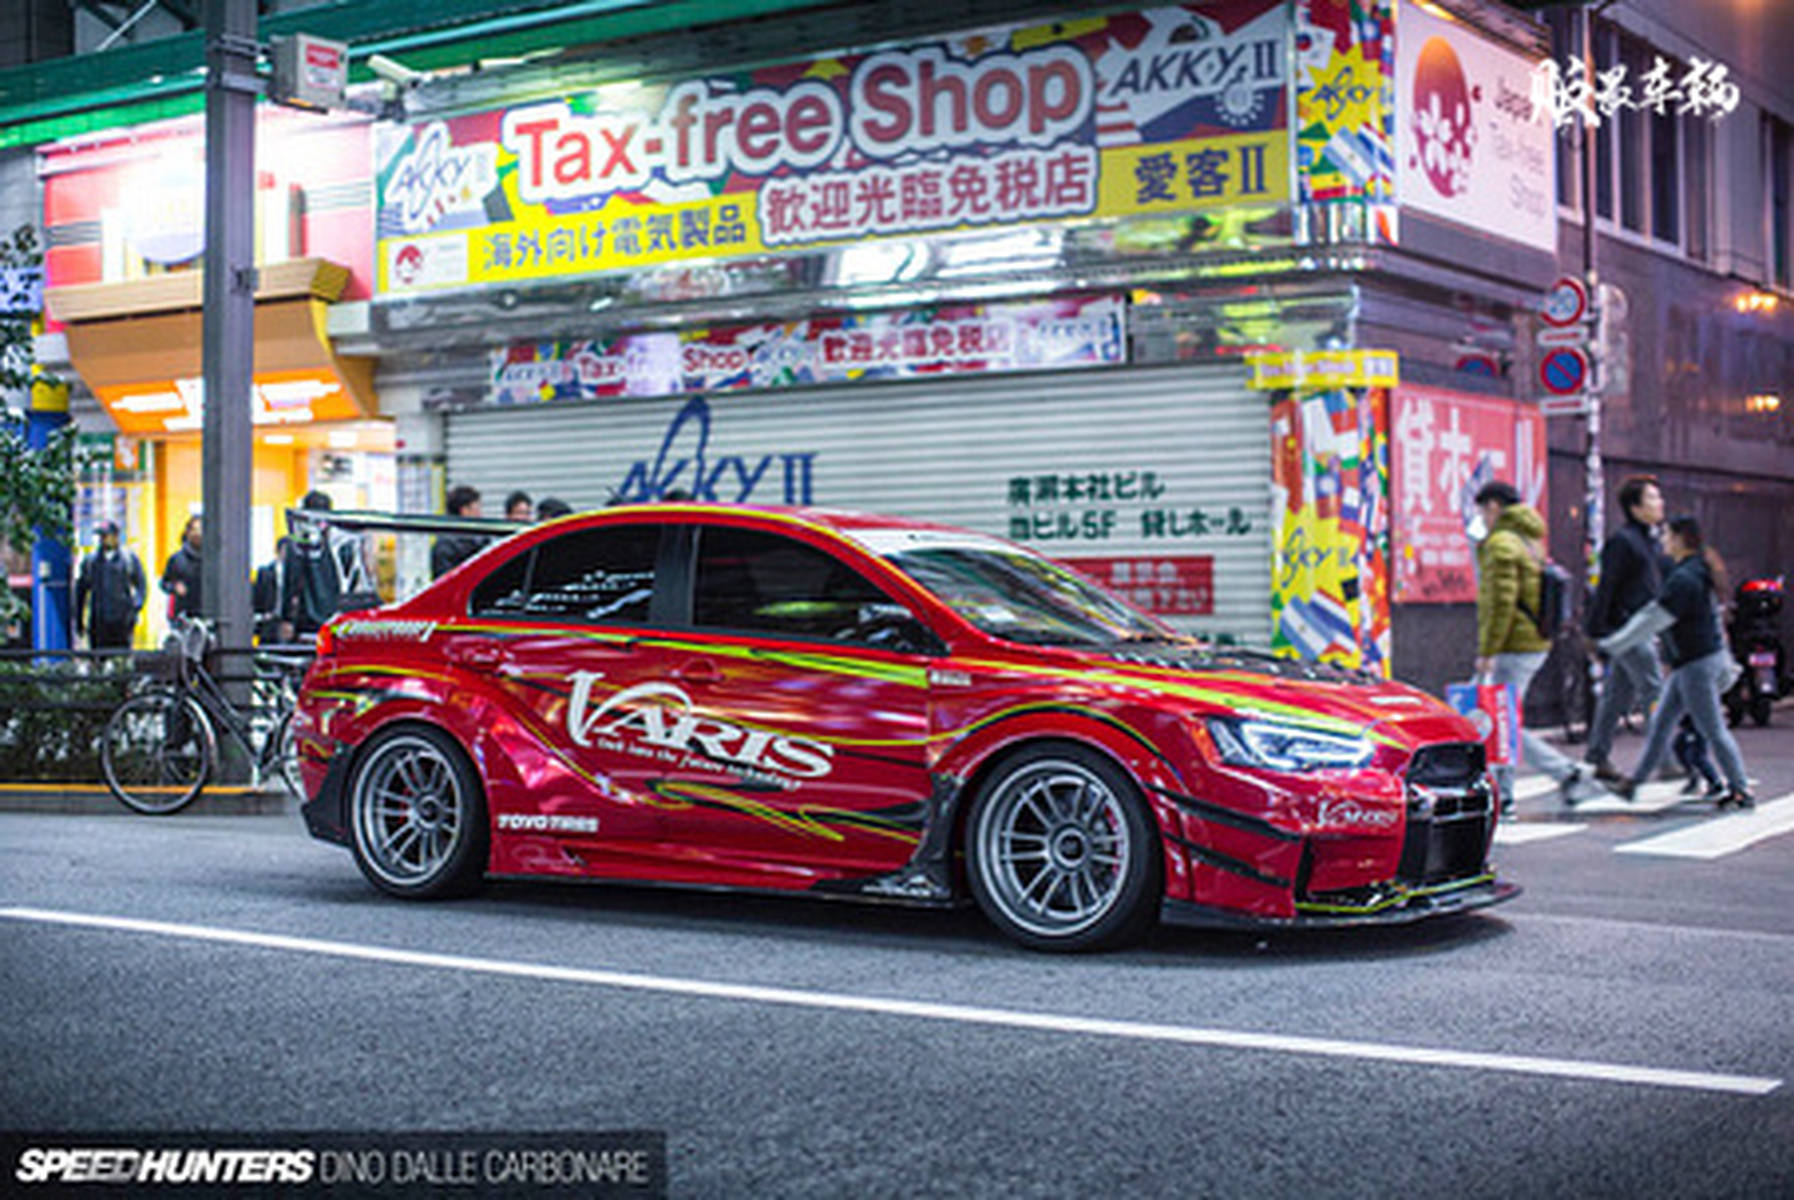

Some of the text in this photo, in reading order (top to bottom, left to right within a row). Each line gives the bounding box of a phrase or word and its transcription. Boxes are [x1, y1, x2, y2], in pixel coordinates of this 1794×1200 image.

[514, 58, 1083, 188] Tax-free Shop
[482, 203, 747, 272] 海外向け電気製品
[564, 669, 836, 778] VARIS
[497, 813, 546, 830] TOYO
